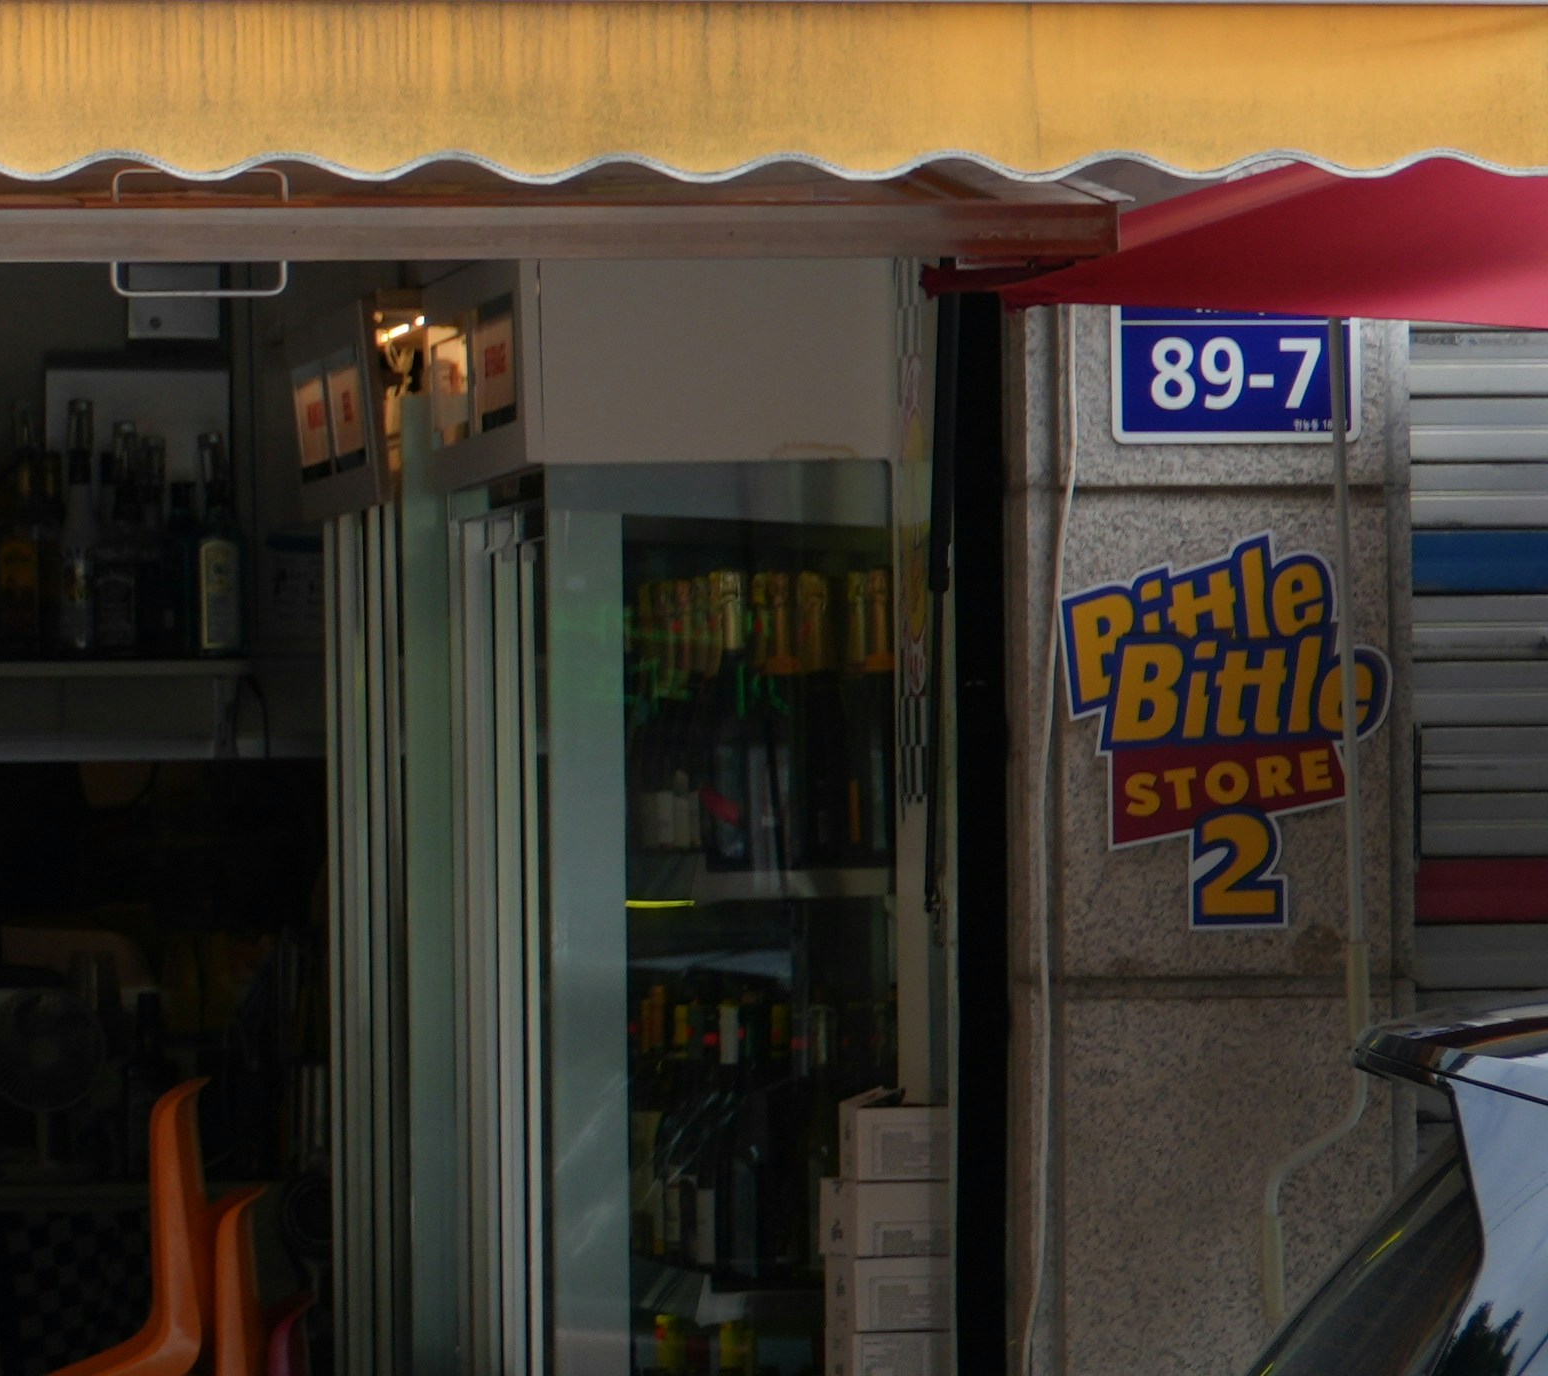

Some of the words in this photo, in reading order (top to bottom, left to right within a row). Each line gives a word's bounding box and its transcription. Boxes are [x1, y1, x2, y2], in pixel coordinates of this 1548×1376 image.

[1151, 336, 1321, 410] 89-7
[1072, 546, 1324, 704] Pittle
[1111, 635, 1373, 742] Bittle
[1124, 748, 1333, 817] STORE
[1200, 813, 1276, 915] 2
